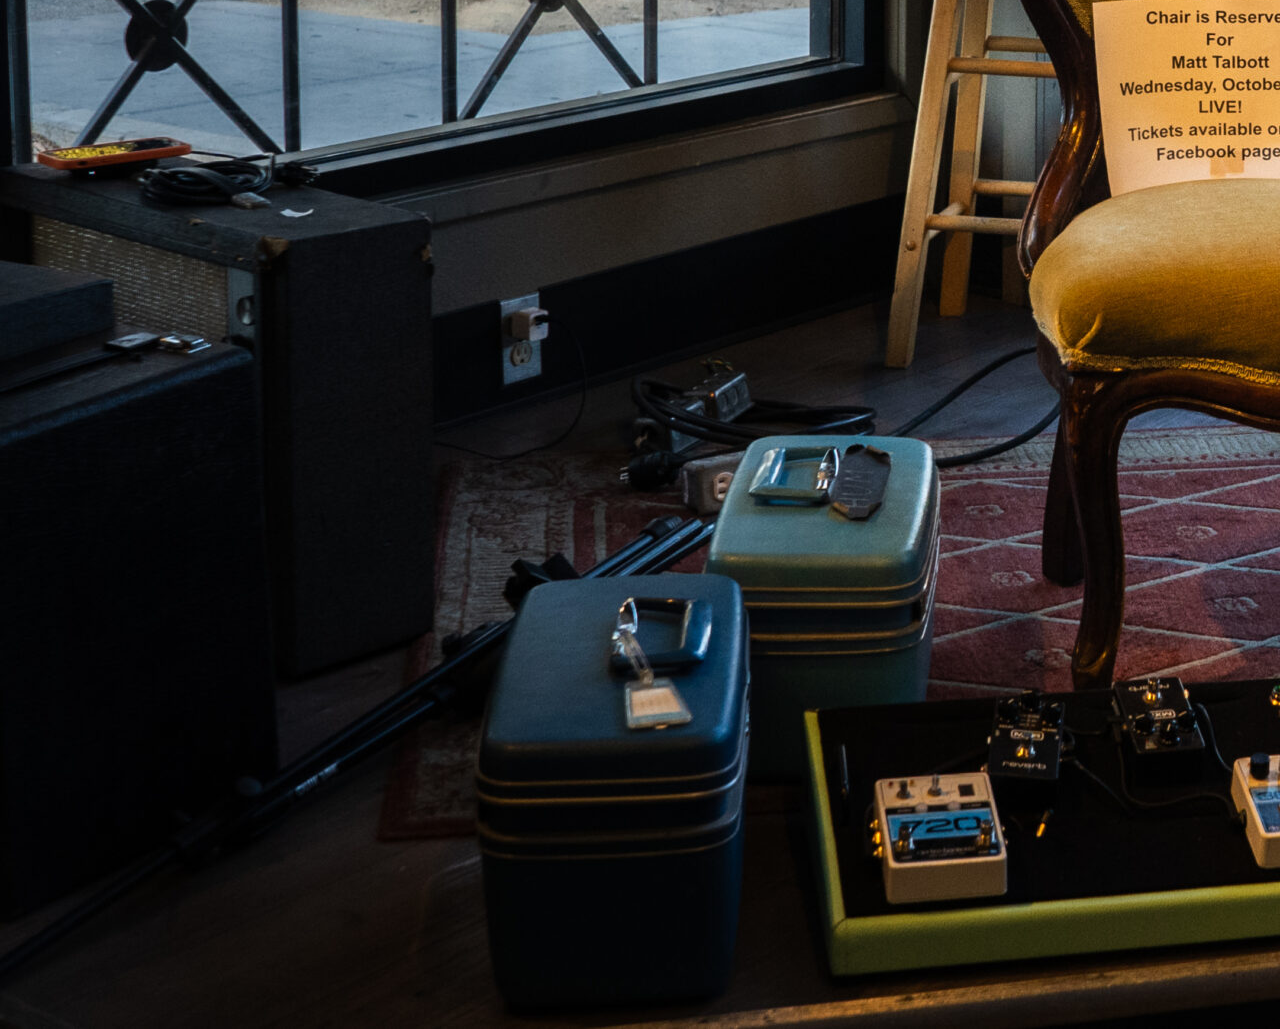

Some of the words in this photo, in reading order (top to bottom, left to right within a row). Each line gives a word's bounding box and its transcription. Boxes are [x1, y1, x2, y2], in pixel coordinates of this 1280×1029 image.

[1146, 10, 1192, 25] Chair
[1196, 10, 1210, 24] is
[1205, 33, 1235, 46] For
[1171, 55, 1208, 69] Matt
[1212, 55, 1270, 69] Talbott
[1119, 78, 1217, 96] Wednesday,
[1198, 100, 1243, 114] LIVE!
[1128, 125, 1184, 142] Tickets
[1189, 122, 1263, 137] available
[1156, 145, 1236, 161] Facebook
[1002, 760, 1047, 771] reverb
[900, 816, 983, 836] 720
